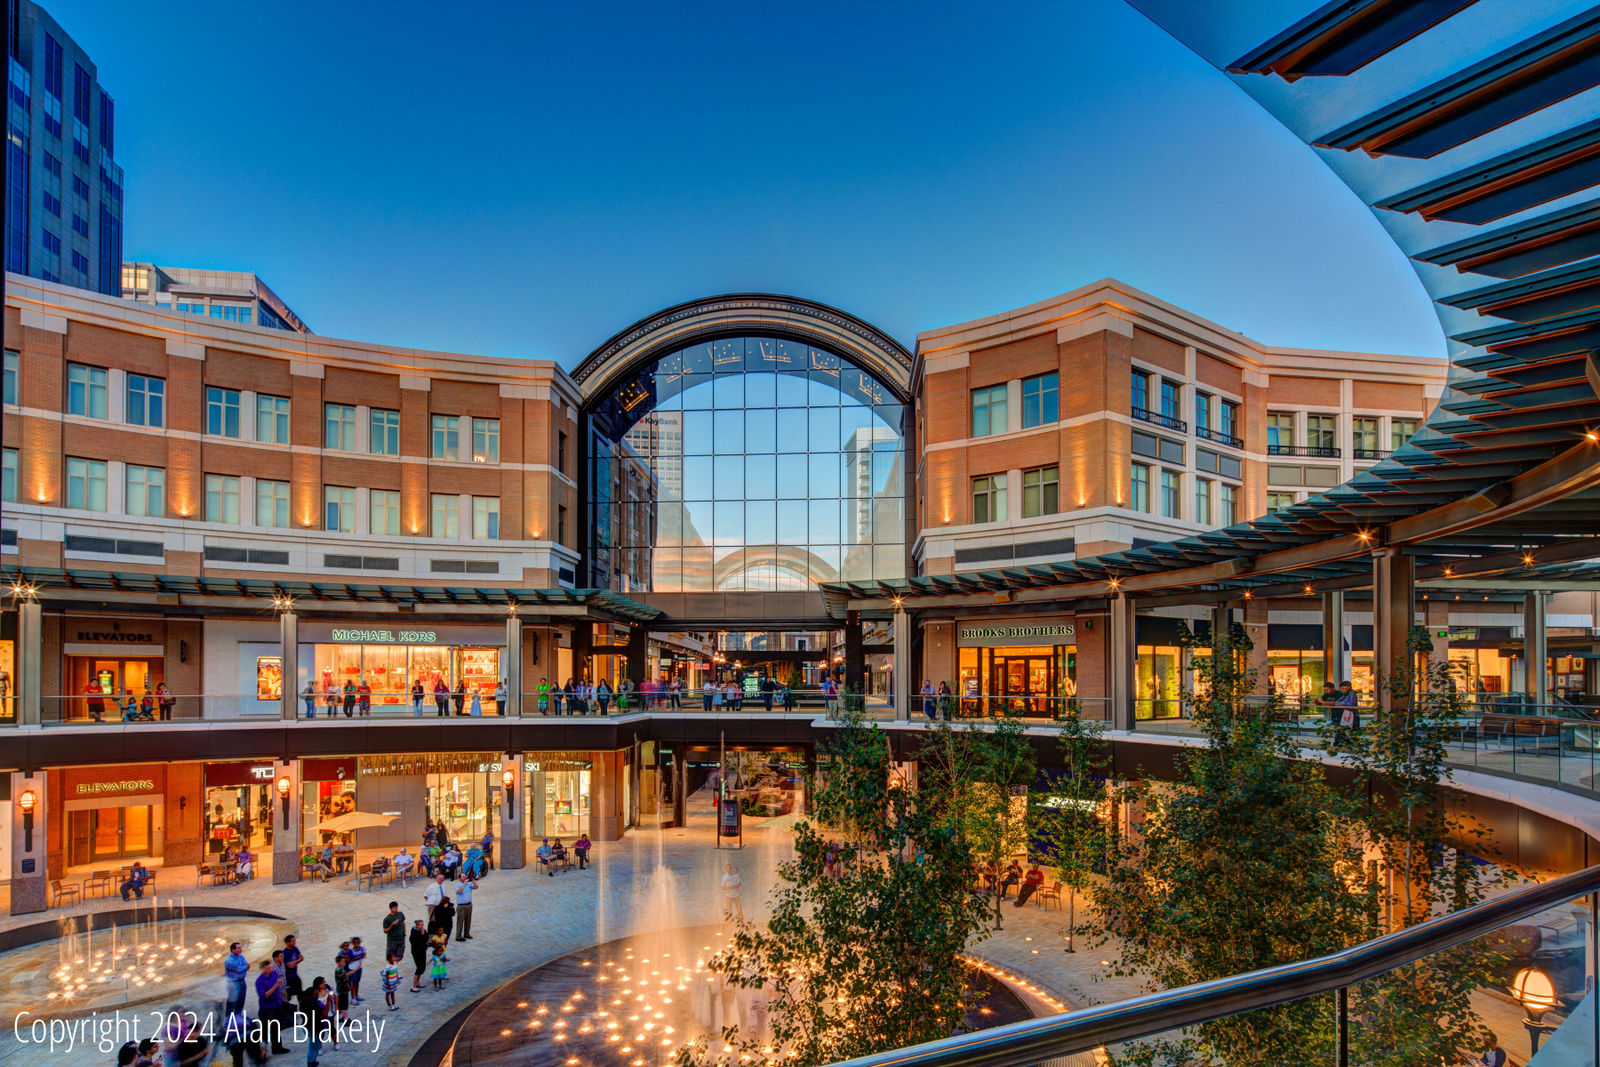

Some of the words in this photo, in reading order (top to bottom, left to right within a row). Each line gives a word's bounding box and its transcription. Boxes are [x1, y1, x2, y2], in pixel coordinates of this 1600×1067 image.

[77, 632, 152, 642] ELEVATORS
[332, 629, 395, 642] MICHAEL
[399, 631, 437, 643] KORS
[962, 628, 1005, 638] BROOKS
[1009, 625, 1074, 637] BROTHERS
[76, 780, 154, 794] ELEVATORS
